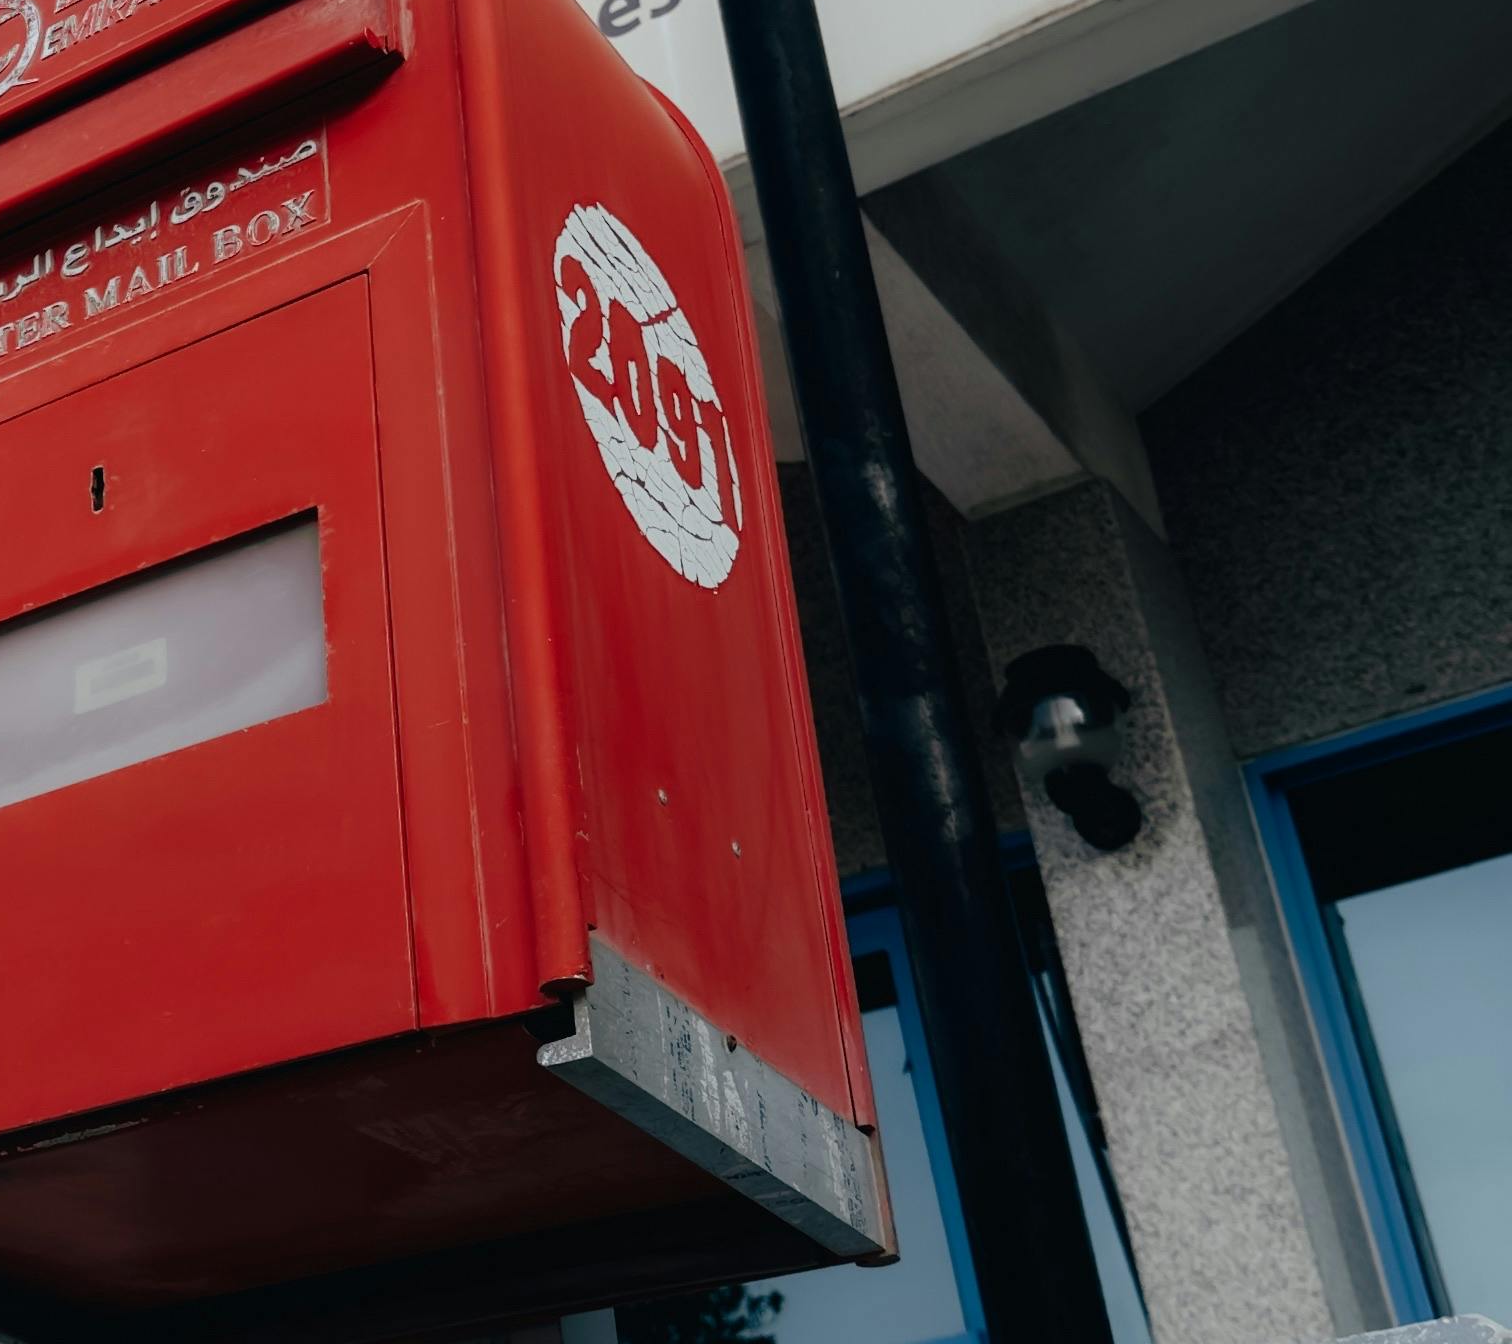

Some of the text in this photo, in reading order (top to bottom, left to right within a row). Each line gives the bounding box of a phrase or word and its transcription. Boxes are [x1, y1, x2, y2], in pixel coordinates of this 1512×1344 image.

[169, 138, 319, 226] صندوق
[59, 200, 160, 281] إيداع
[84, 244, 200, 321] MAIL
[212, 188, 318, 265] BOX
[557, 254, 738, 526] 2091
